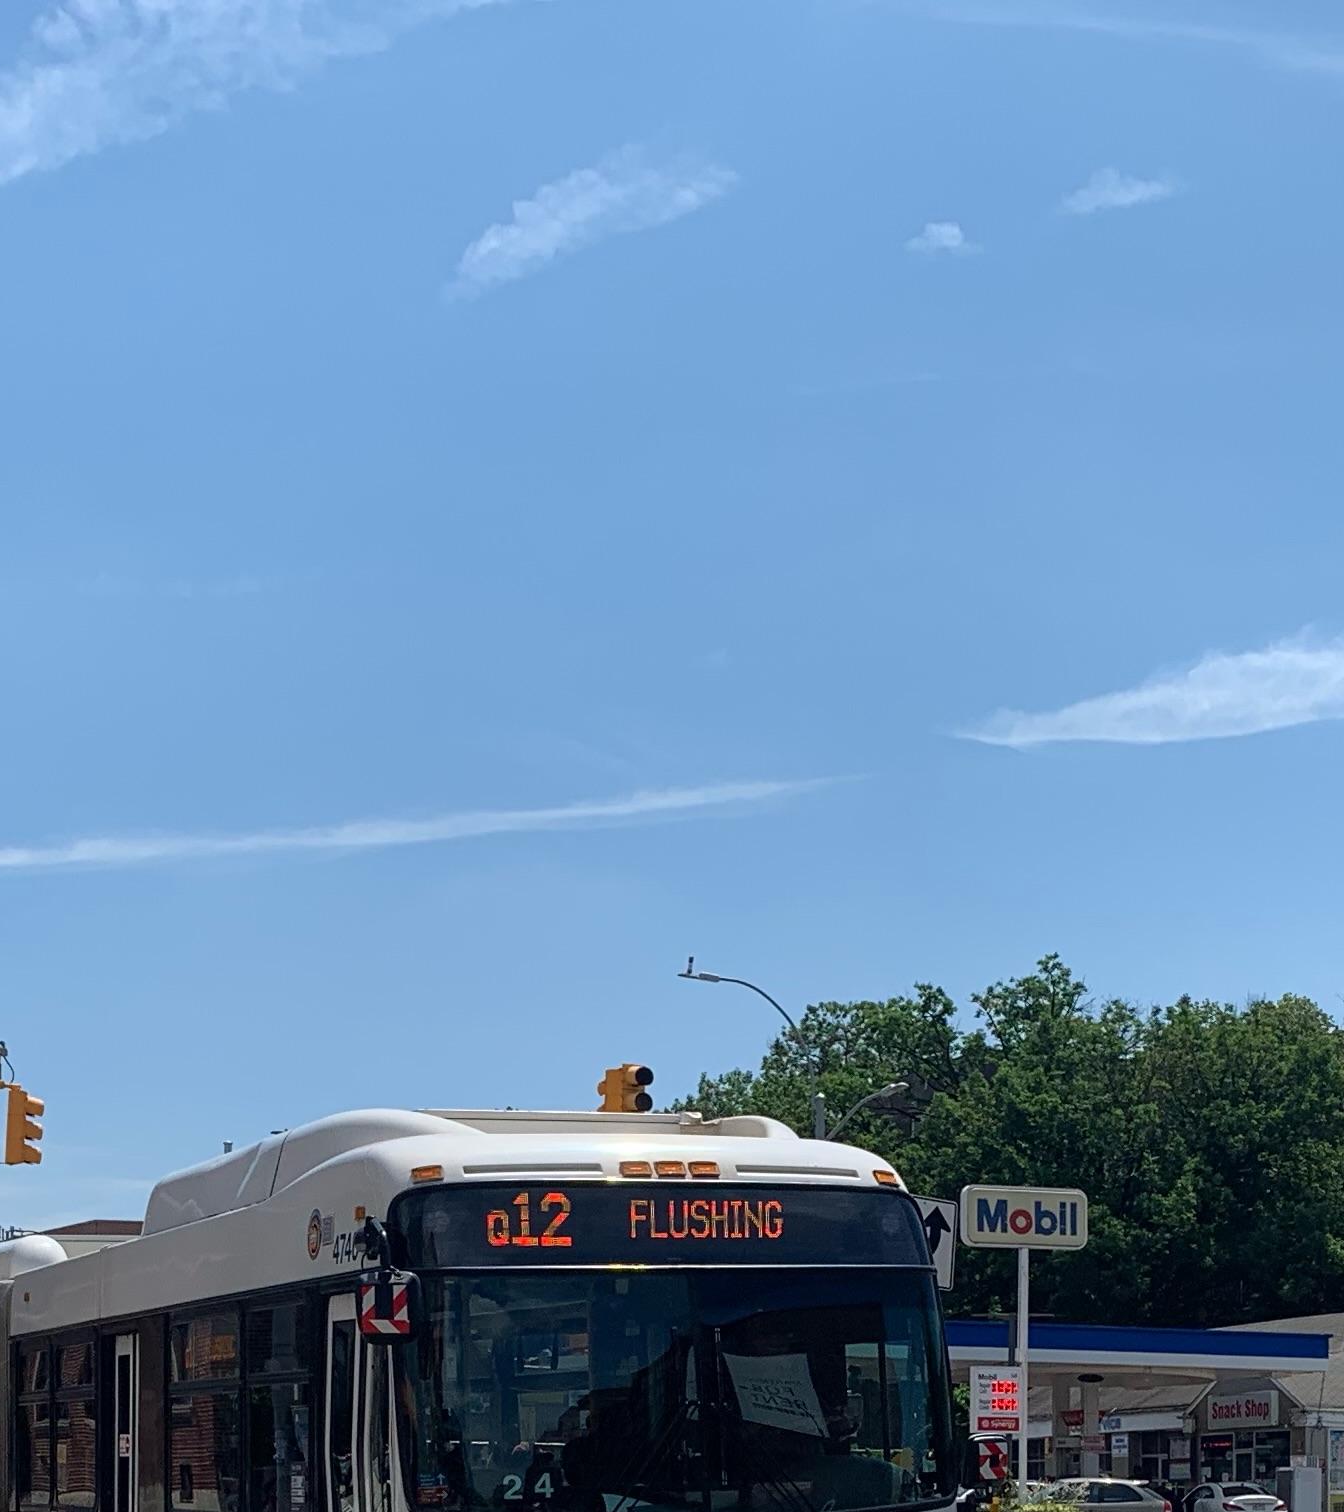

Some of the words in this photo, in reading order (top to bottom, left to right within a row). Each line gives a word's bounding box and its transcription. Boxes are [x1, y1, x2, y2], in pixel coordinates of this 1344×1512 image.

[629, 1200, 784, 1239] FLUSHING
[977, 1197, 1077, 1236] Mobil
[1212, 1400, 1241, 1419] Snack
[1245, 1400, 1269, 1420] Shop
